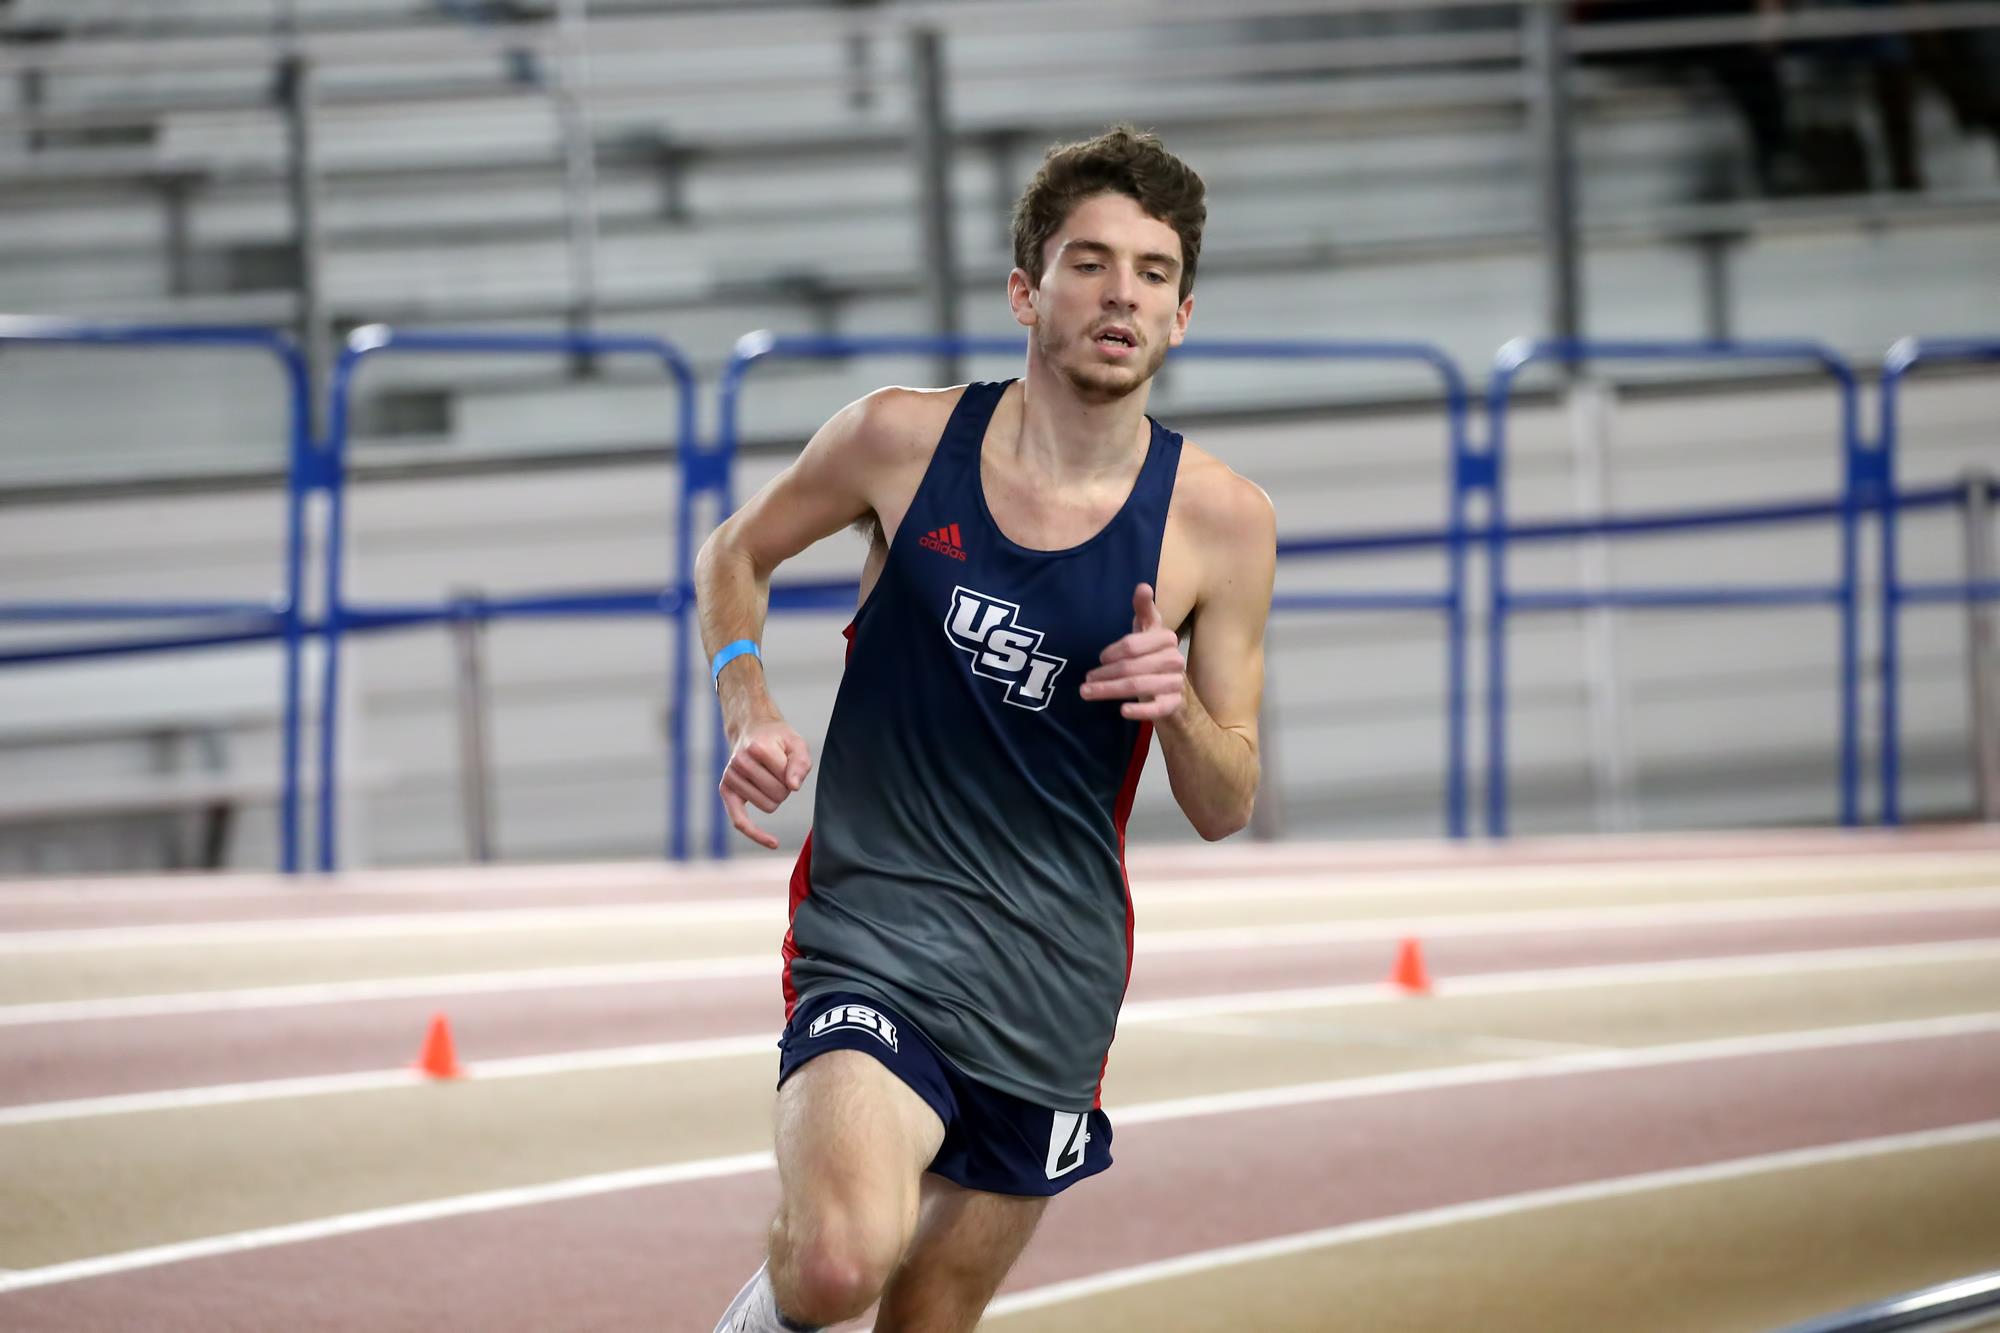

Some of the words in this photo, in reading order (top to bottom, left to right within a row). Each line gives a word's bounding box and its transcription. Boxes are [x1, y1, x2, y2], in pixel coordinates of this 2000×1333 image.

[920, 536, 967, 560] adidas
[950, 594, 1058, 701] USI
[812, 1006, 895, 1047] USI
